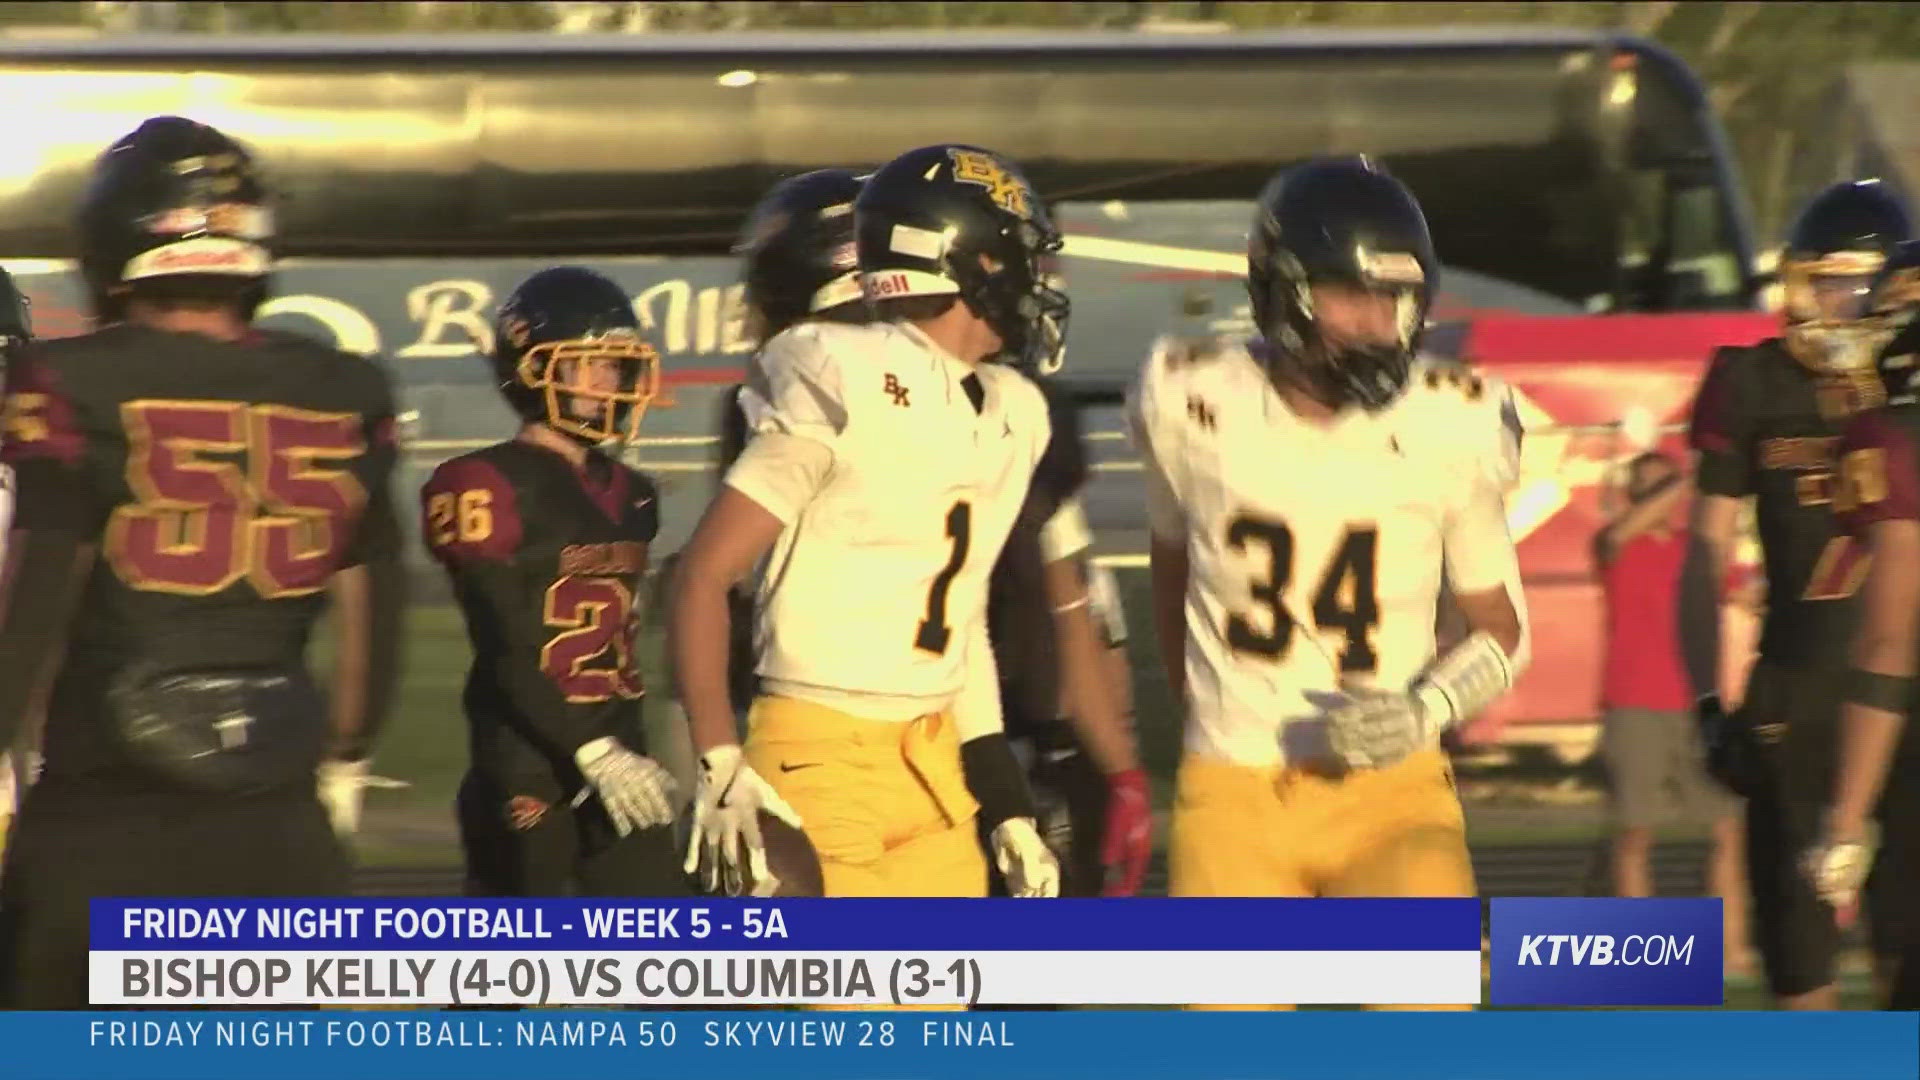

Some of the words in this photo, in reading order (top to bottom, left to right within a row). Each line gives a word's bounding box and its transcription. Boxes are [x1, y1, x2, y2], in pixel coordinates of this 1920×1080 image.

[883, 372, 911, 408] BK
[103, 399, 369, 599] 55
[430, 489, 493, 545] 26
[914, 500, 973, 656] 1
[1226, 512, 1379, 676] 34
